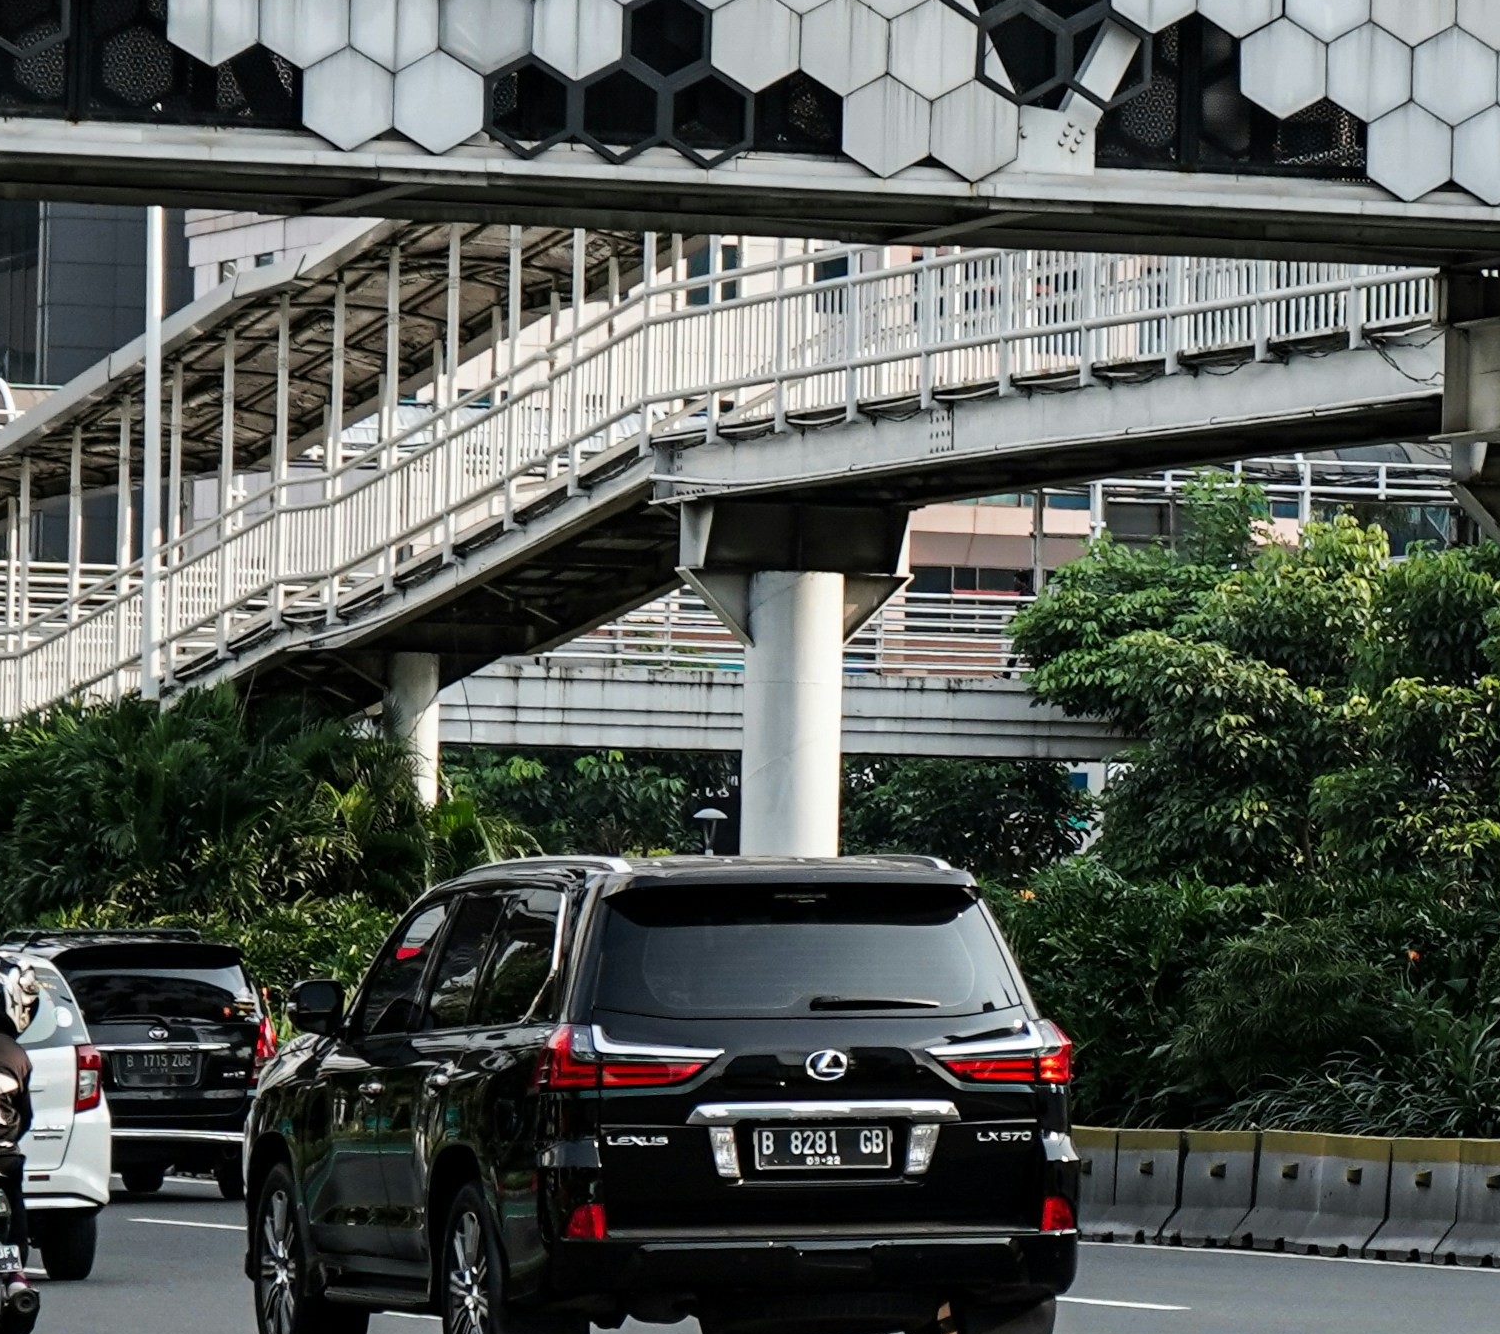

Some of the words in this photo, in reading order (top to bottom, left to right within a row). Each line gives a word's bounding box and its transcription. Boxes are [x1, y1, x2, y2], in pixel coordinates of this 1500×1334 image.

[126, 1054, 134, 1067] B
[143, 1054, 168, 1067] 1715
[606, 1135, 669, 1147] LEXUS
[761, 1131, 775, 1155] B
[790, 1130, 838, 1155] 8281
[859, 1129, 884, 1154] GB
